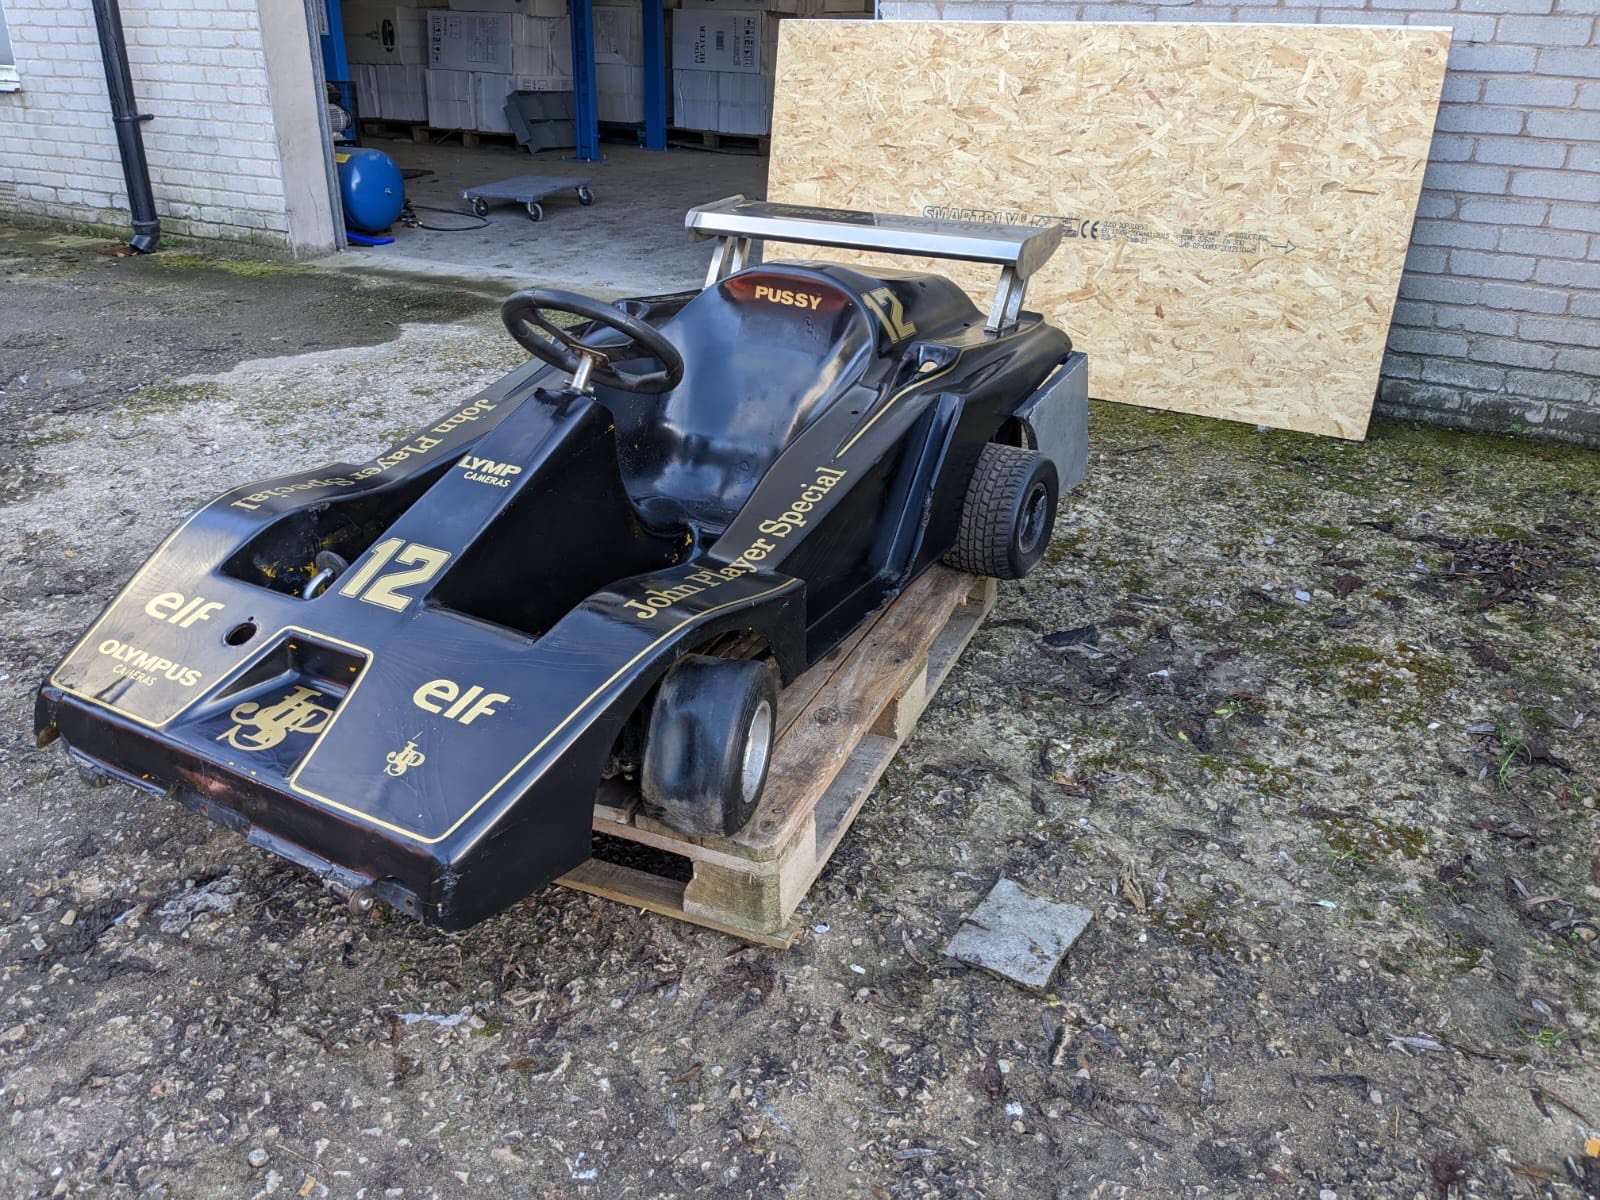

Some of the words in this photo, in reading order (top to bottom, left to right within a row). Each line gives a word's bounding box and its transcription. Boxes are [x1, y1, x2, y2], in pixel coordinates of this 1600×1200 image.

[755, 285, 822, 310] PUSSY
[861, 286, 918, 344] 12
[435, 398, 497, 434] John
[351, 435, 443, 481] Player
[458, 455, 523, 477] LYMP
[230, 476, 354, 512] Special
[463, 471, 512, 488] CAMERAS
[624, 581, 706, 619] John
[696, 538, 776, 588] Player
[758, 466, 847, 538] Special
[338, 537, 452, 613] 12
[144, 591, 225, 628] elf
[98, 638, 203, 687] OLYMPUS
[412, 678, 512, 725] elf
